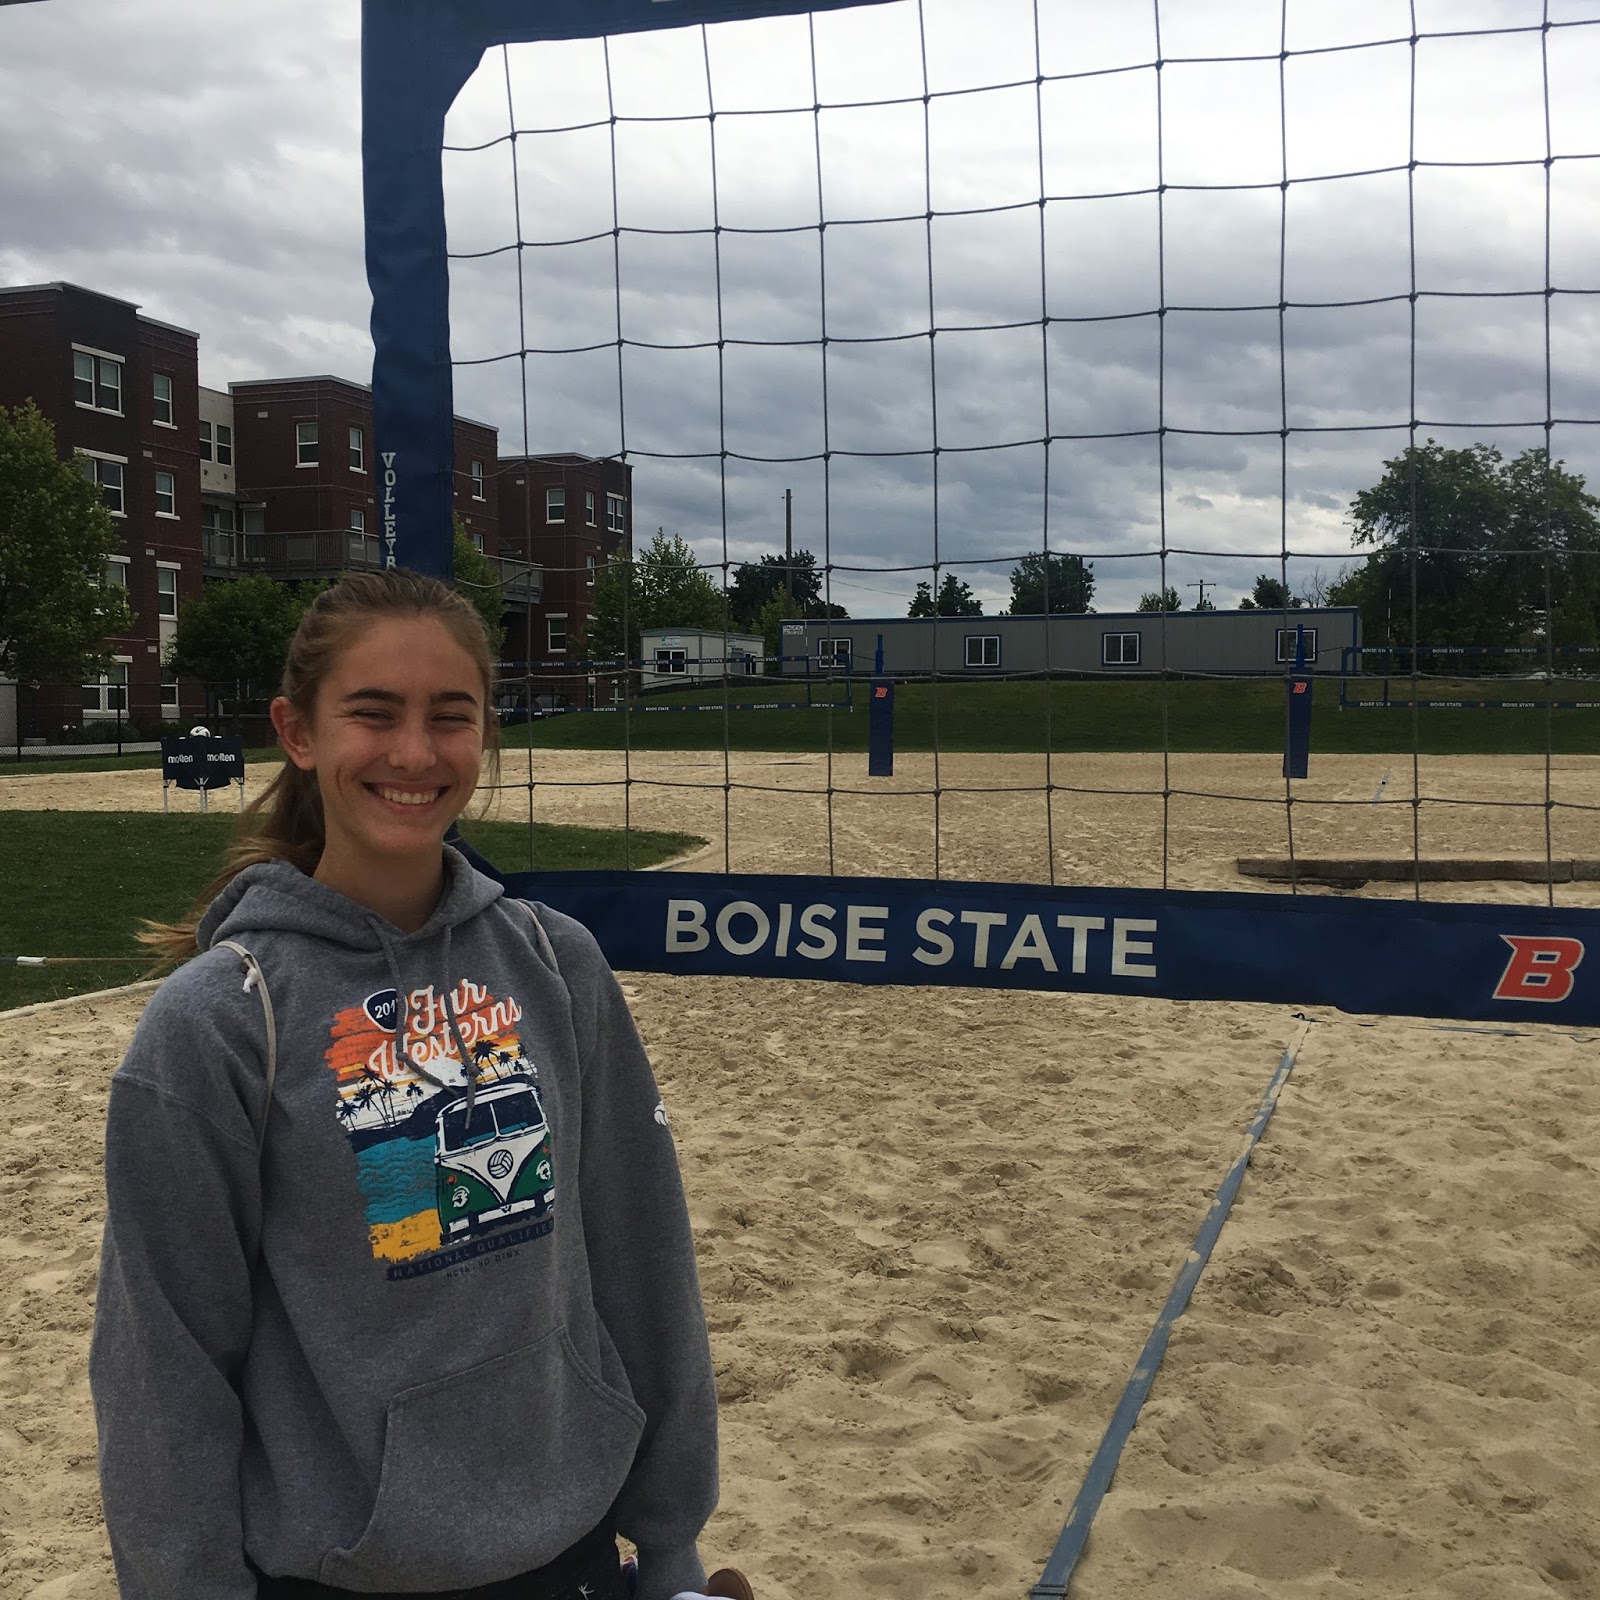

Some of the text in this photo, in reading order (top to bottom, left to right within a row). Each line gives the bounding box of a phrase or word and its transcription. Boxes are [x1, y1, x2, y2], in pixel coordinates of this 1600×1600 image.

[168, 754, 193, 764] molten
[207, 753, 235, 762] molten
[665, 899, 1158, 977] BOISE STATE
[1492, 934, 1585, 1003] B
[411, 978, 487, 1035] Far
[369, 996, 522, 1081] Westerns
[393, 1249, 471, 1278] NATIONAL
